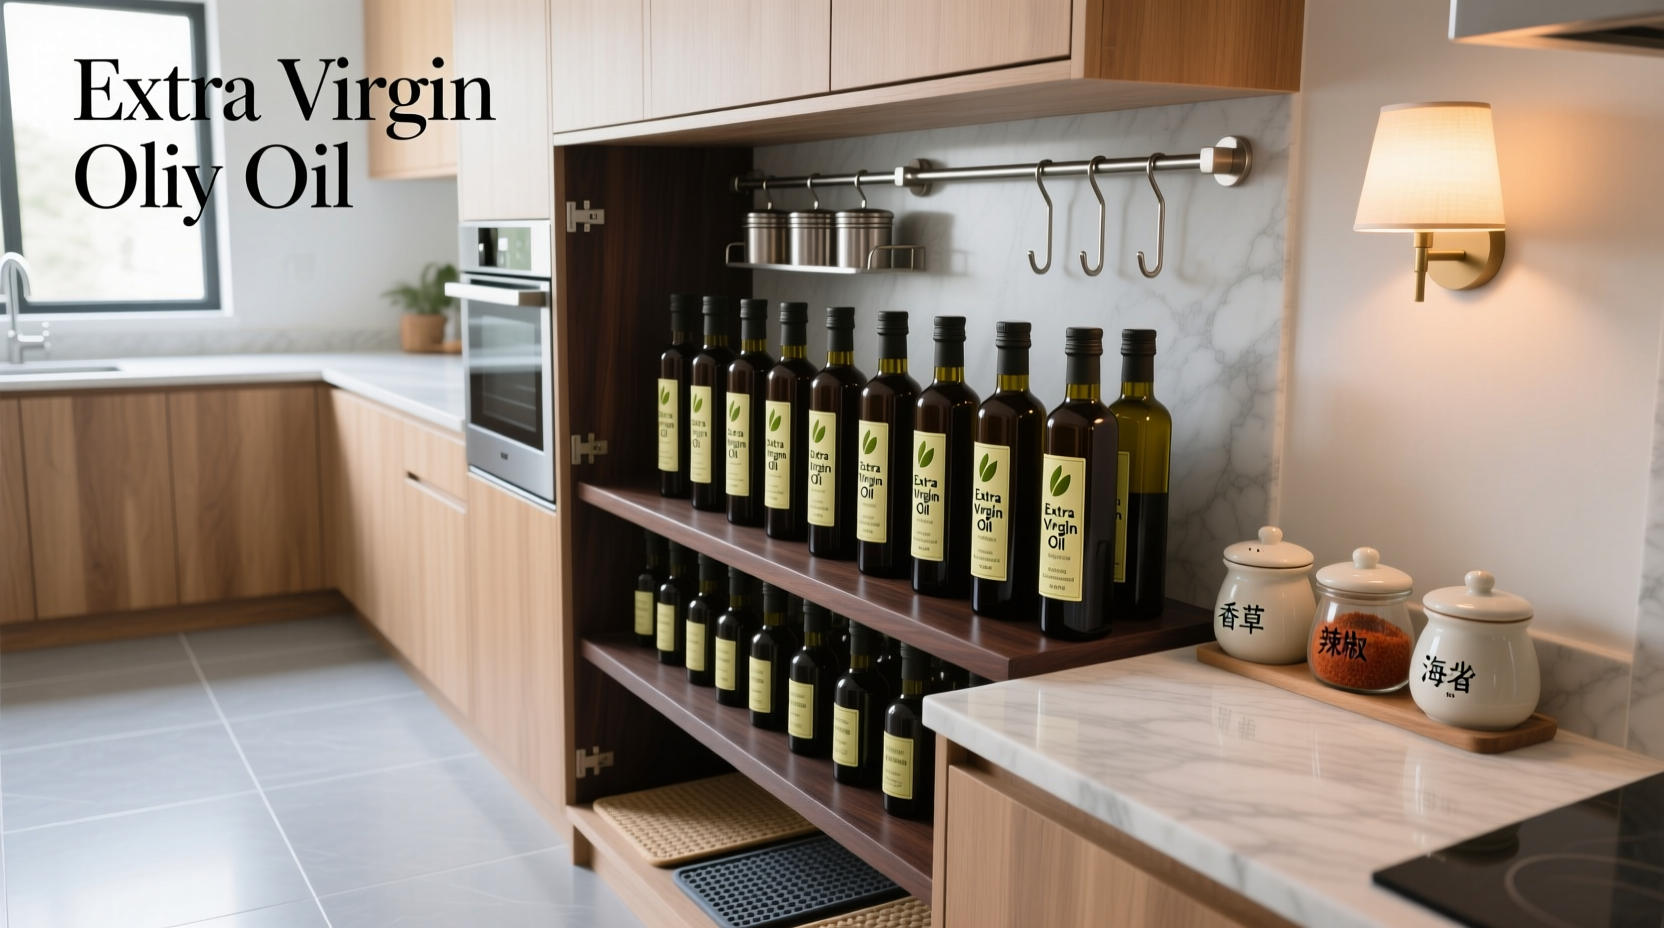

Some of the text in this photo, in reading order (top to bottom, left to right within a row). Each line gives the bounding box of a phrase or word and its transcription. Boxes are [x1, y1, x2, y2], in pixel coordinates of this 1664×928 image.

[914, 474, 938, 488] Extra
[860, 486, 874, 499] Oil
[975, 488, 1002, 503] Extra
[916, 502, 930, 515] Oil
[1045, 502, 1075, 518] Extra
[977, 519, 992, 532] Oil
[1048, 535, 1065, 550] Oil
[1218, 601, 1265, 635] 香草
[1317, 626, 1368, 662] 辣椒
